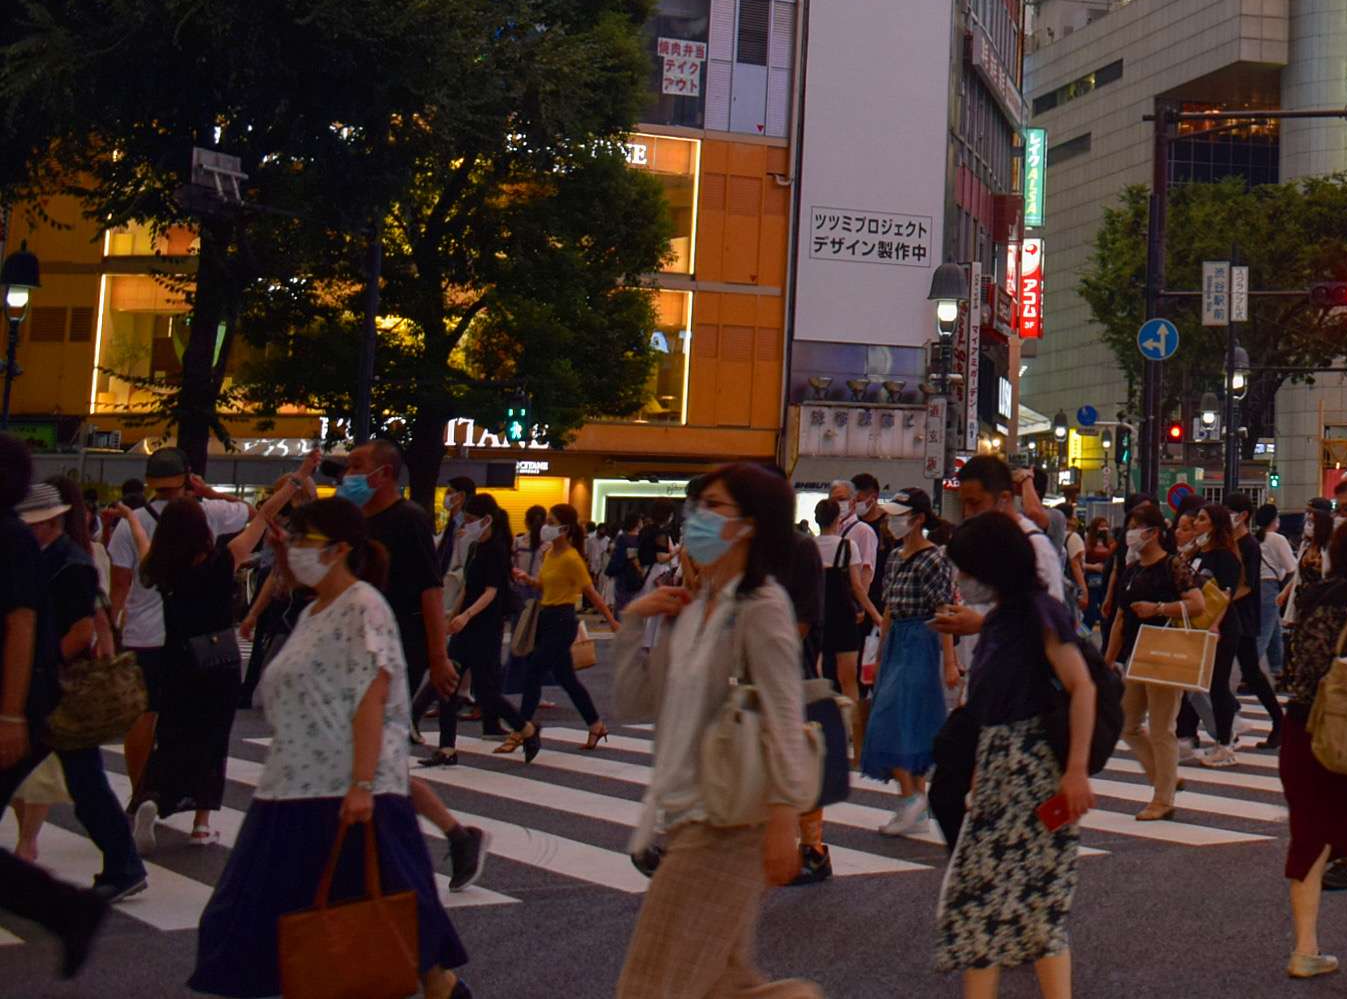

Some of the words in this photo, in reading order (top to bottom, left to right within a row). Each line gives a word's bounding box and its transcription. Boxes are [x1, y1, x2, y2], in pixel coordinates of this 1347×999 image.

[657, 39, 706, 61] 焼肉弁当
[664, 58, 700, 76] テイク
[663, 76, 699, 94] アウト
[814, 213, 929, 239] ツツミプロジェクト
[812, 235, 928, 263] デザイン製作中
[1022, 277, 1038, 318] アコム
